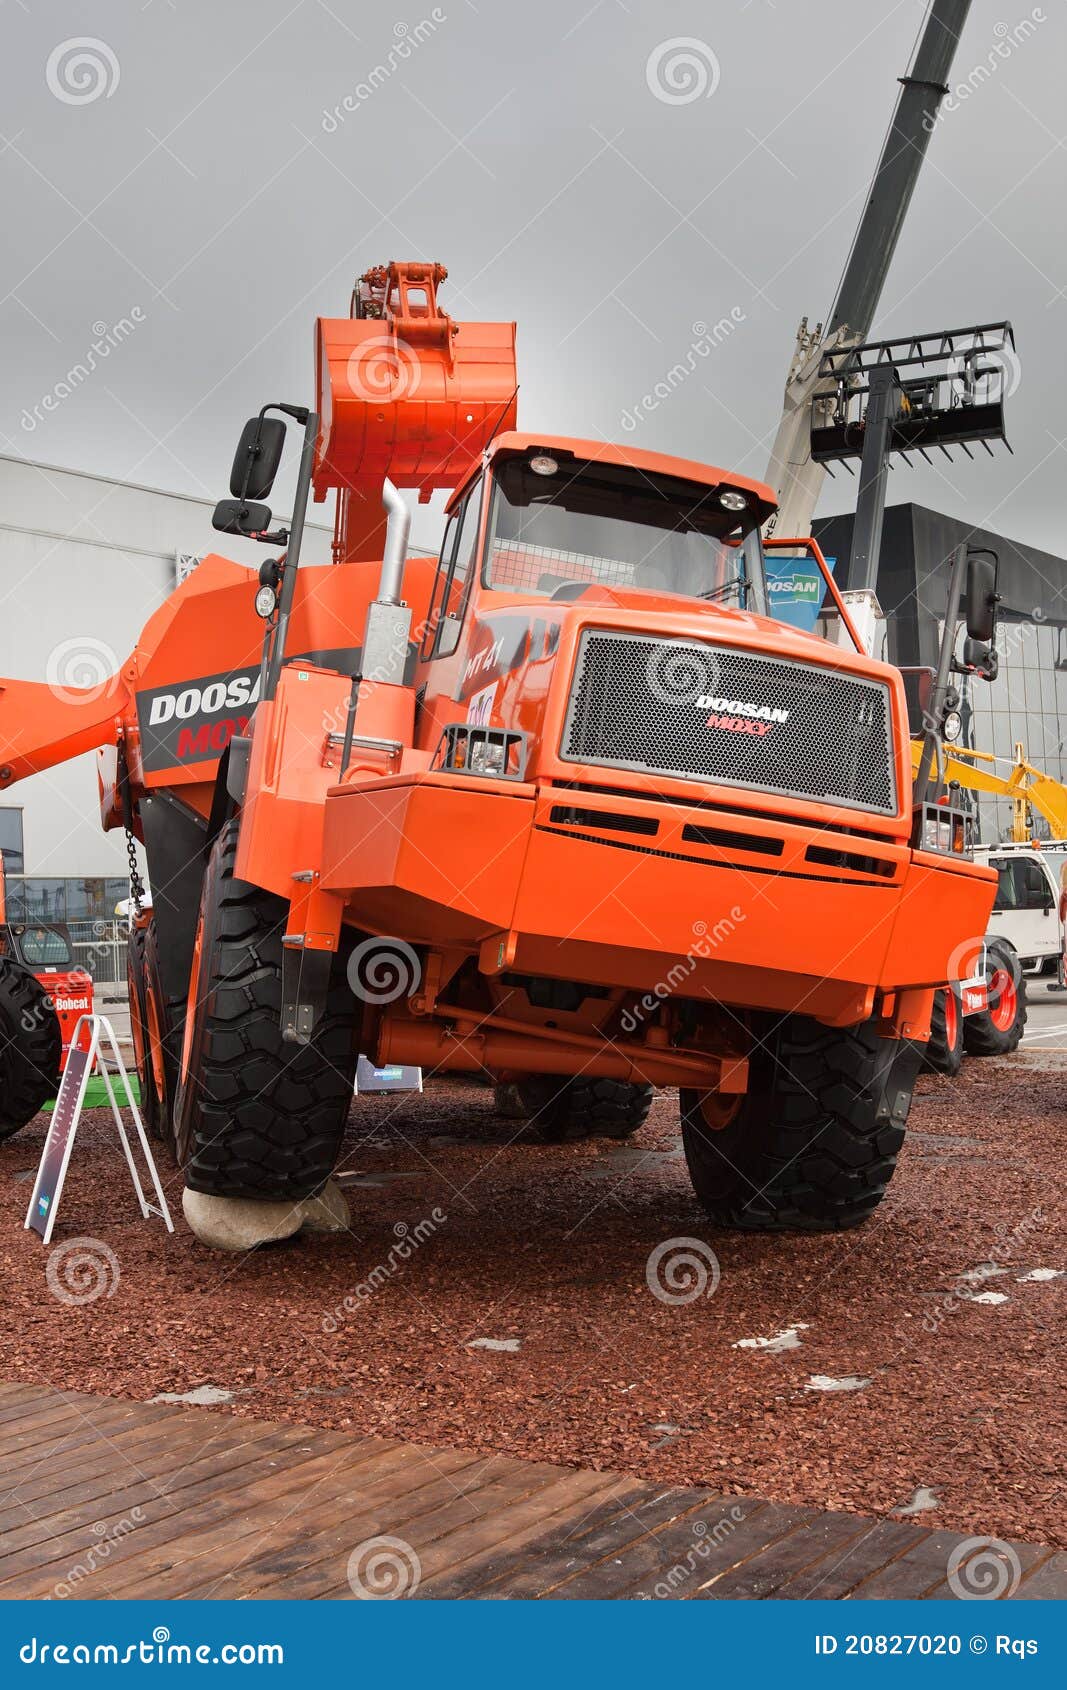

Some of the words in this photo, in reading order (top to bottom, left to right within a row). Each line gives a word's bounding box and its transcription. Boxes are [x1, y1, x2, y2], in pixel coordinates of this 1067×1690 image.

[766, 581, 817, 593] OSAN
[149, 673, 261, 726] DOOS
[695, 695, 790, 723] DOOSAN
[176, 715, 249, 758] MO
[706, 714, 774, 737] MOXY
[56, 997, 89, 1011] Bobcat
